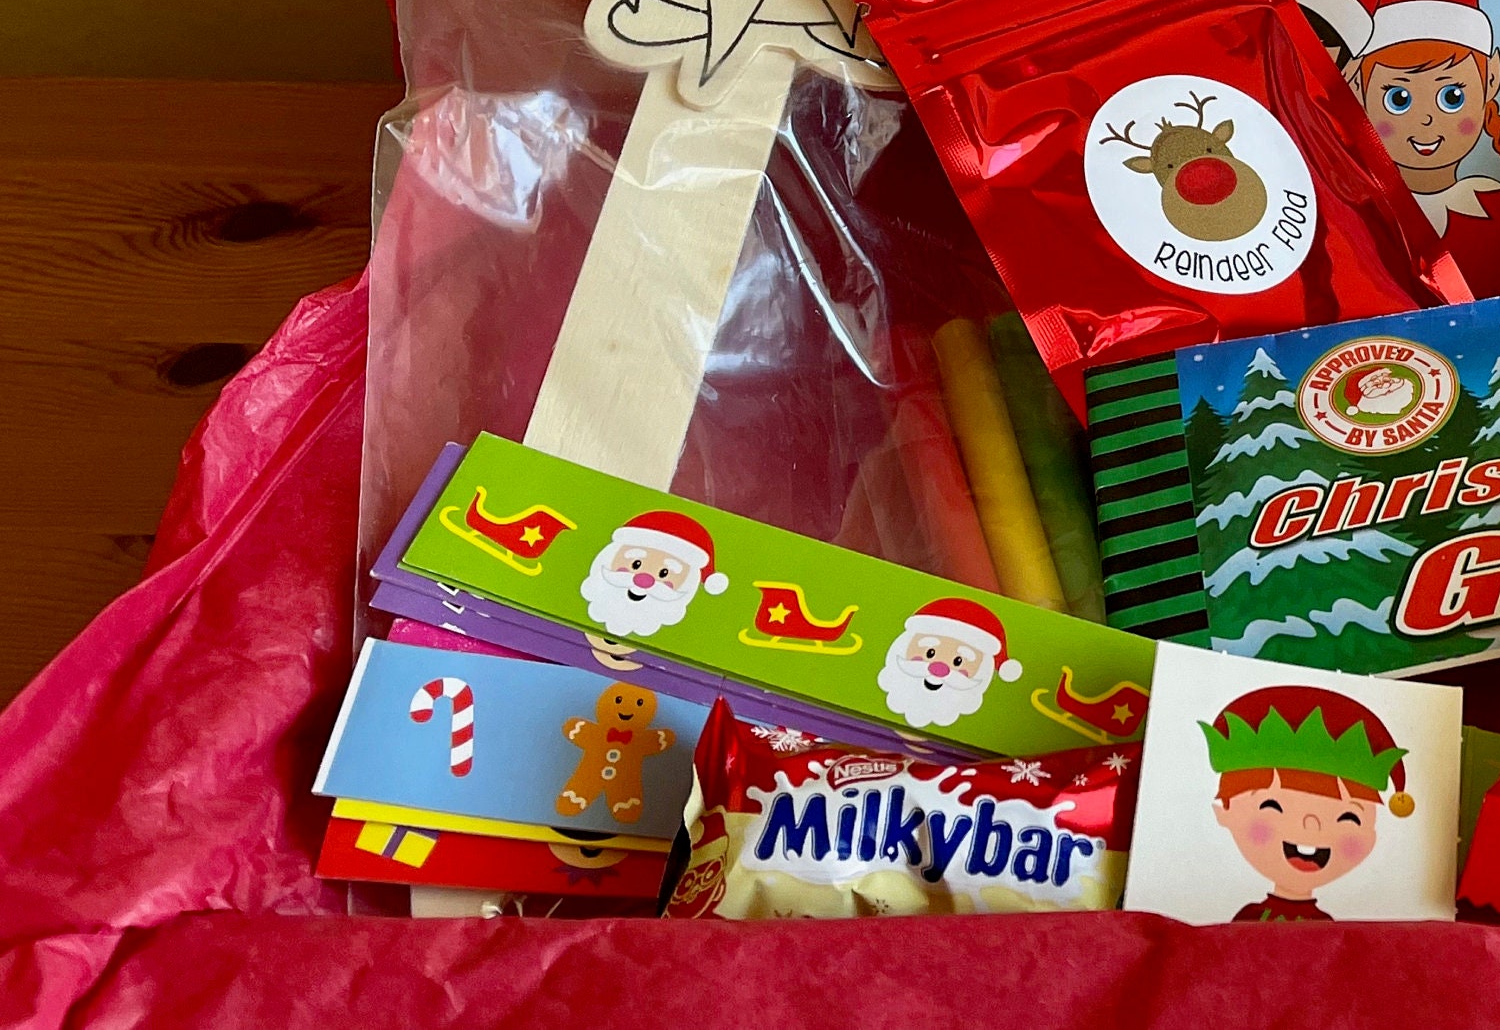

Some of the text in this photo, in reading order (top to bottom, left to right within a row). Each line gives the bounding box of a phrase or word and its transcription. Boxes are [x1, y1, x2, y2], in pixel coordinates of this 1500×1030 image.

[1308, 344, 1415, 392] APPROVED
[1344, 401, 1444, 448] BY SANTA
[753, 785, 1094, 886] Milkybar
